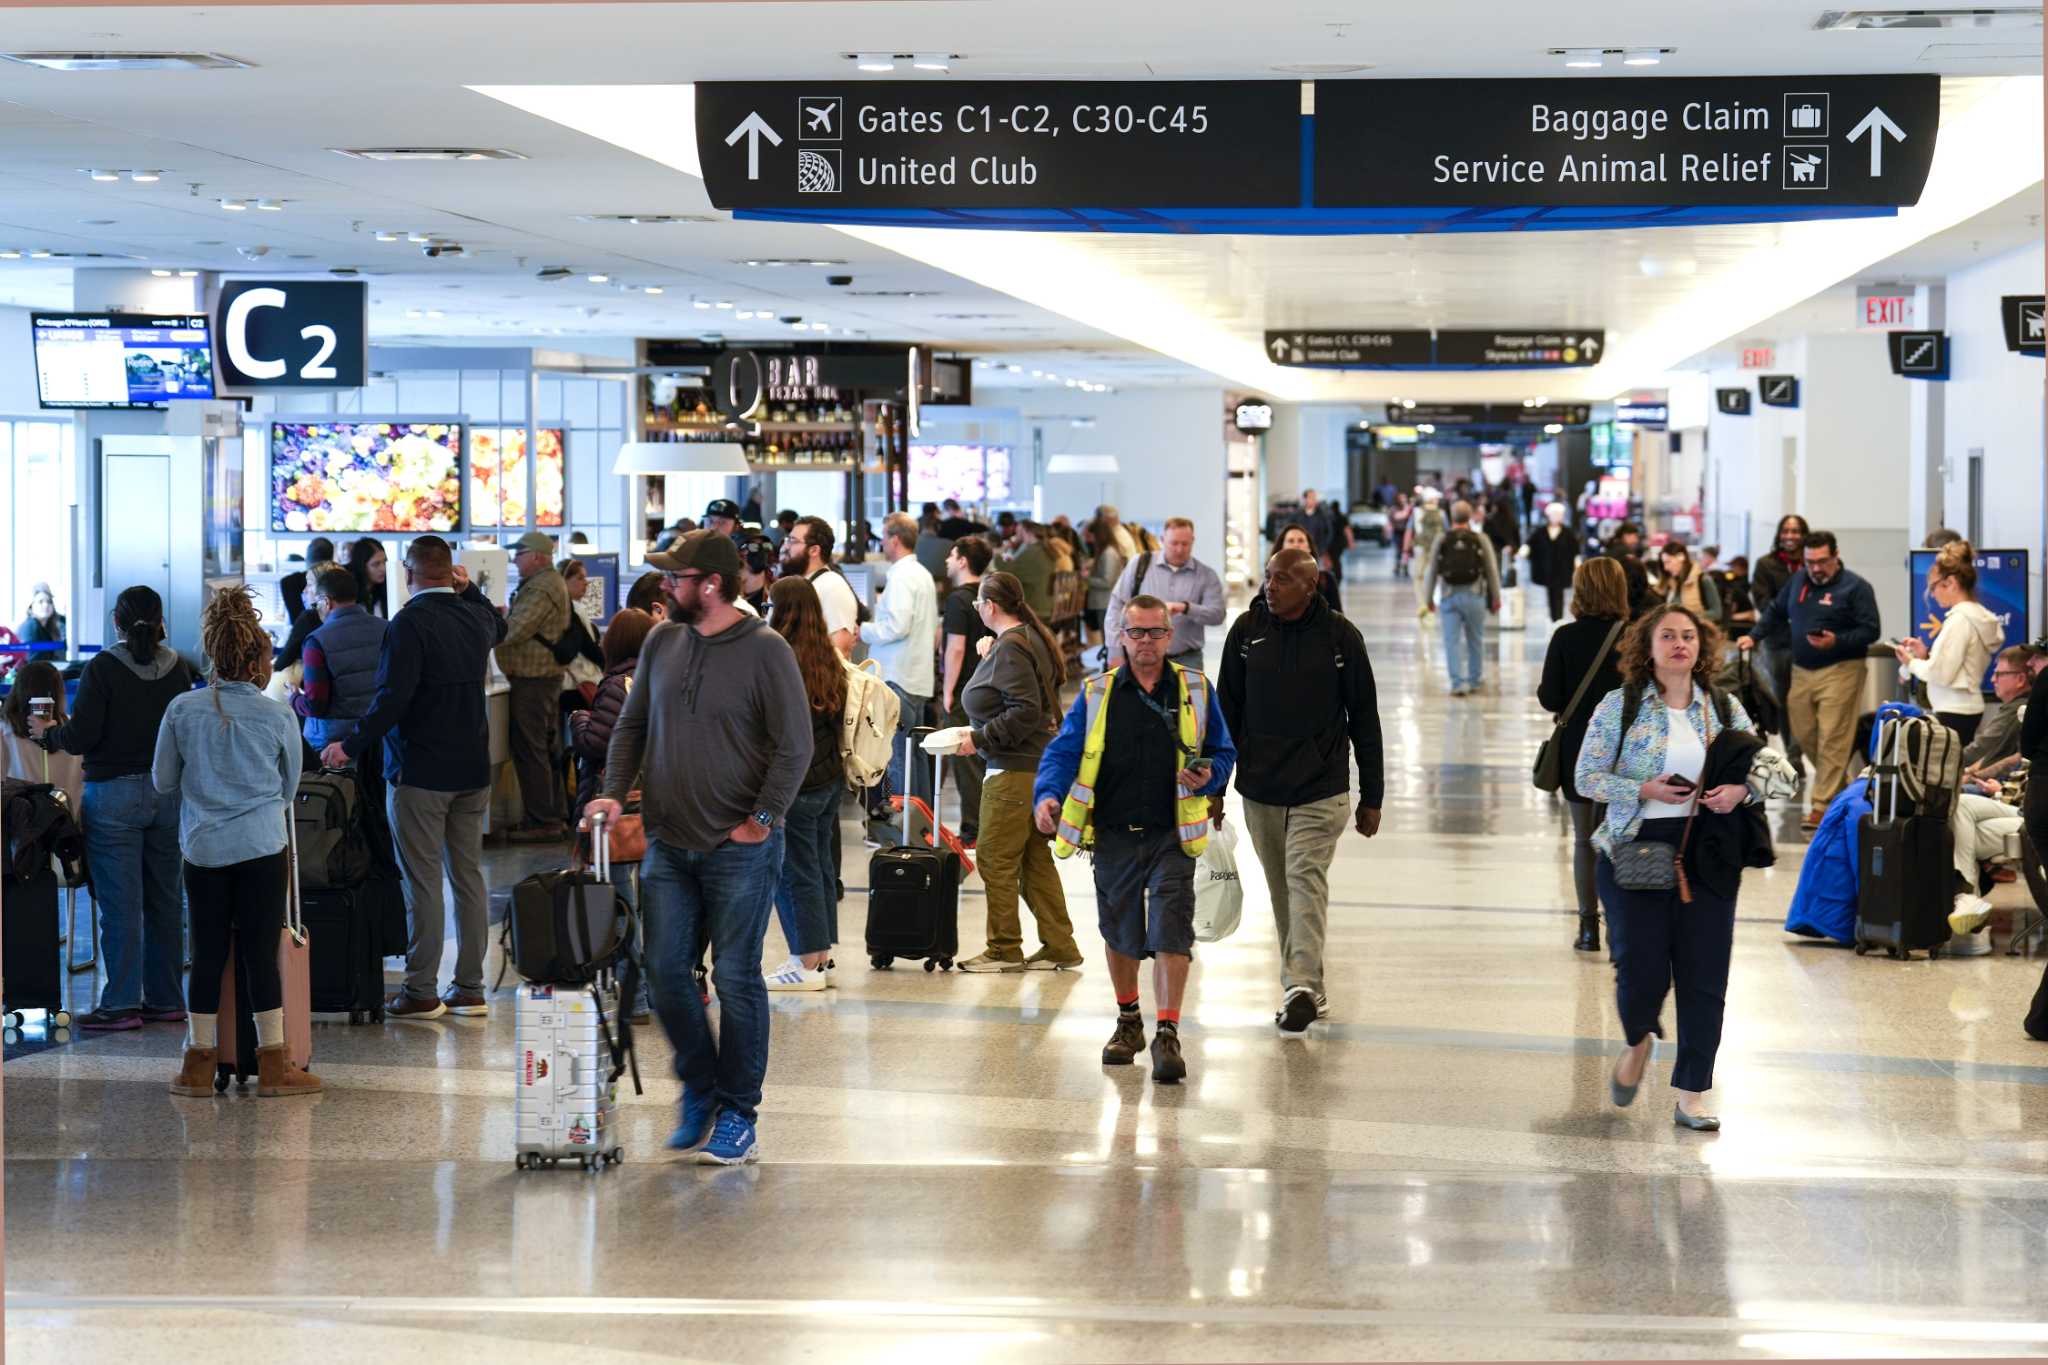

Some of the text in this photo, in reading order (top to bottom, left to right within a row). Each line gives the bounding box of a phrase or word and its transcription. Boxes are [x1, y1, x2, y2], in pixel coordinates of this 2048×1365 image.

[858, 105, 1208, 137] Gates C1-C2, C30-C45
[1532, 101, 1769, 140] Baggage Claim
[857, 156, 1037, 185] United Club
[1433, 152, 1771, 183] Service Animal Relief
[1866, 296, 1905, 324] EXIT
[190, 319, 204, 328] C2
[1307, 335, 1333, 347] Gates
[1494, 335, 1561, 347] Baggage Claim
[1307, 350, 1360, 361] United Club
[1743, 348, 1770, 369] EXIT
[767, 355, 820, 387] BAR
[768, 386, 807, 401] TEXAS
